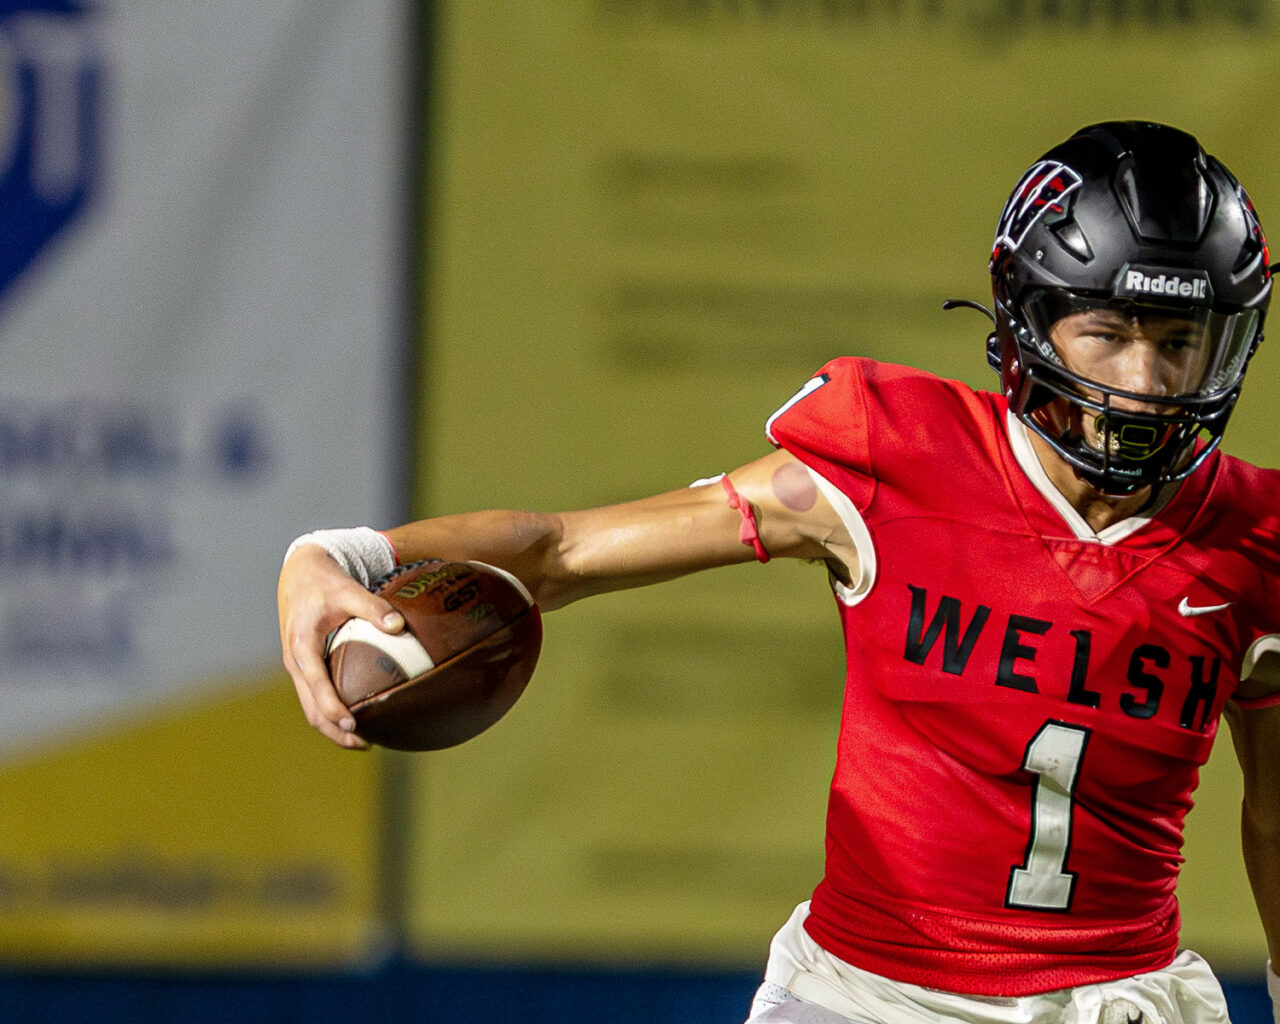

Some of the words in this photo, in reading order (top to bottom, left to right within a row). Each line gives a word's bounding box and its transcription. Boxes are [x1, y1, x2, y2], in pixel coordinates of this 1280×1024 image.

[1125, 269, 1207, 299] Riddell
[903, 583, 1222, 731] WELSH
[1003, 718, 1092, 914] 1
